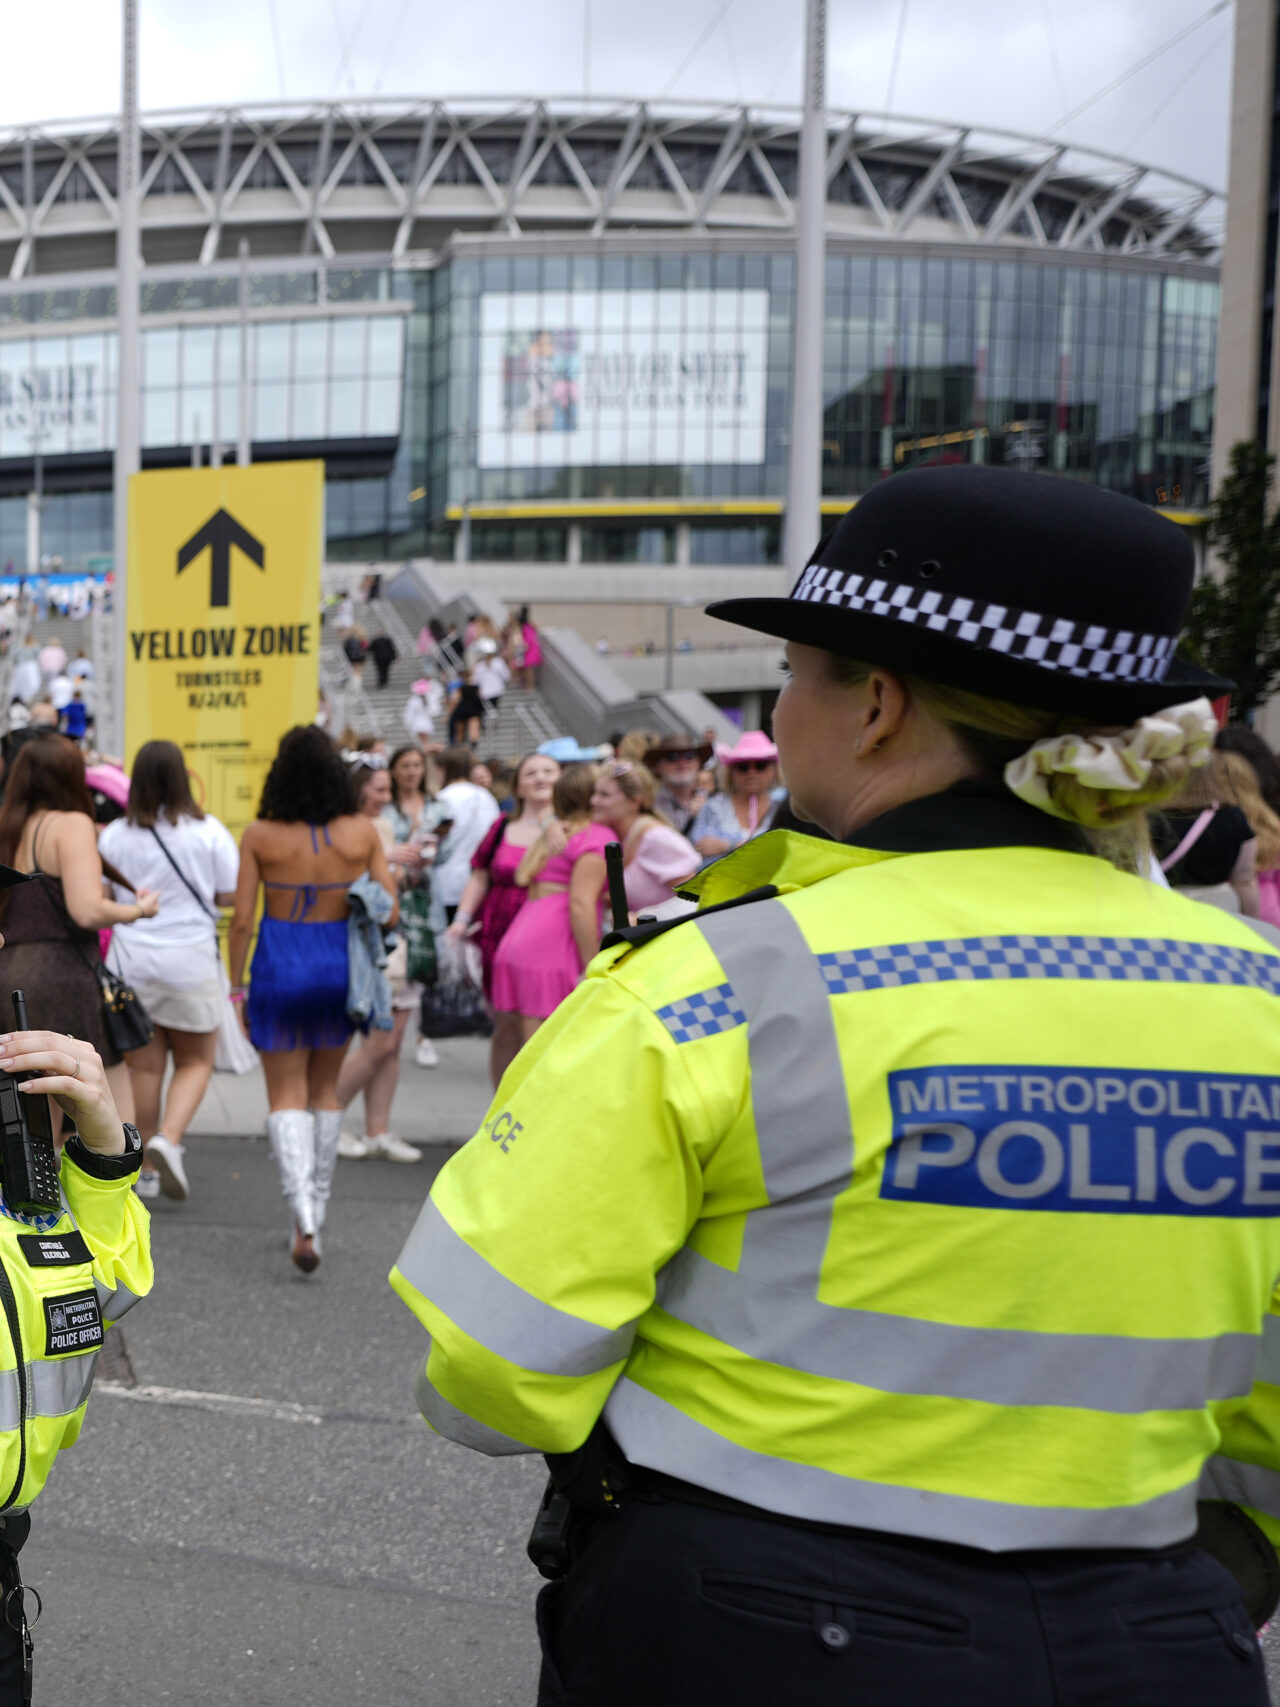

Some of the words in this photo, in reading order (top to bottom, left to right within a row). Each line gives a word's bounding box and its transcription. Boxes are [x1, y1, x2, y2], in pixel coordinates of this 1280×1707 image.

[21, 363, 97, 402] SWIFT
[34, 407, 98, 428] TOUR
[130, 629, 236, 662] YELLOW
[243, 624, 310, 657] ZONE
[176, 670, 262, 688] TURNSTILES
[897, 1075, 1280, 1121] METROPOLITA
[893, 1121, 1280, 1206] POLICE
[65, 1301, 96, 1314] METROPOLITAN
[71, 1313, 94, 1325] POLICE
[51, 1331, 78, 1349] POLICE
[79, 1326, 102, 1343] OFFICER
